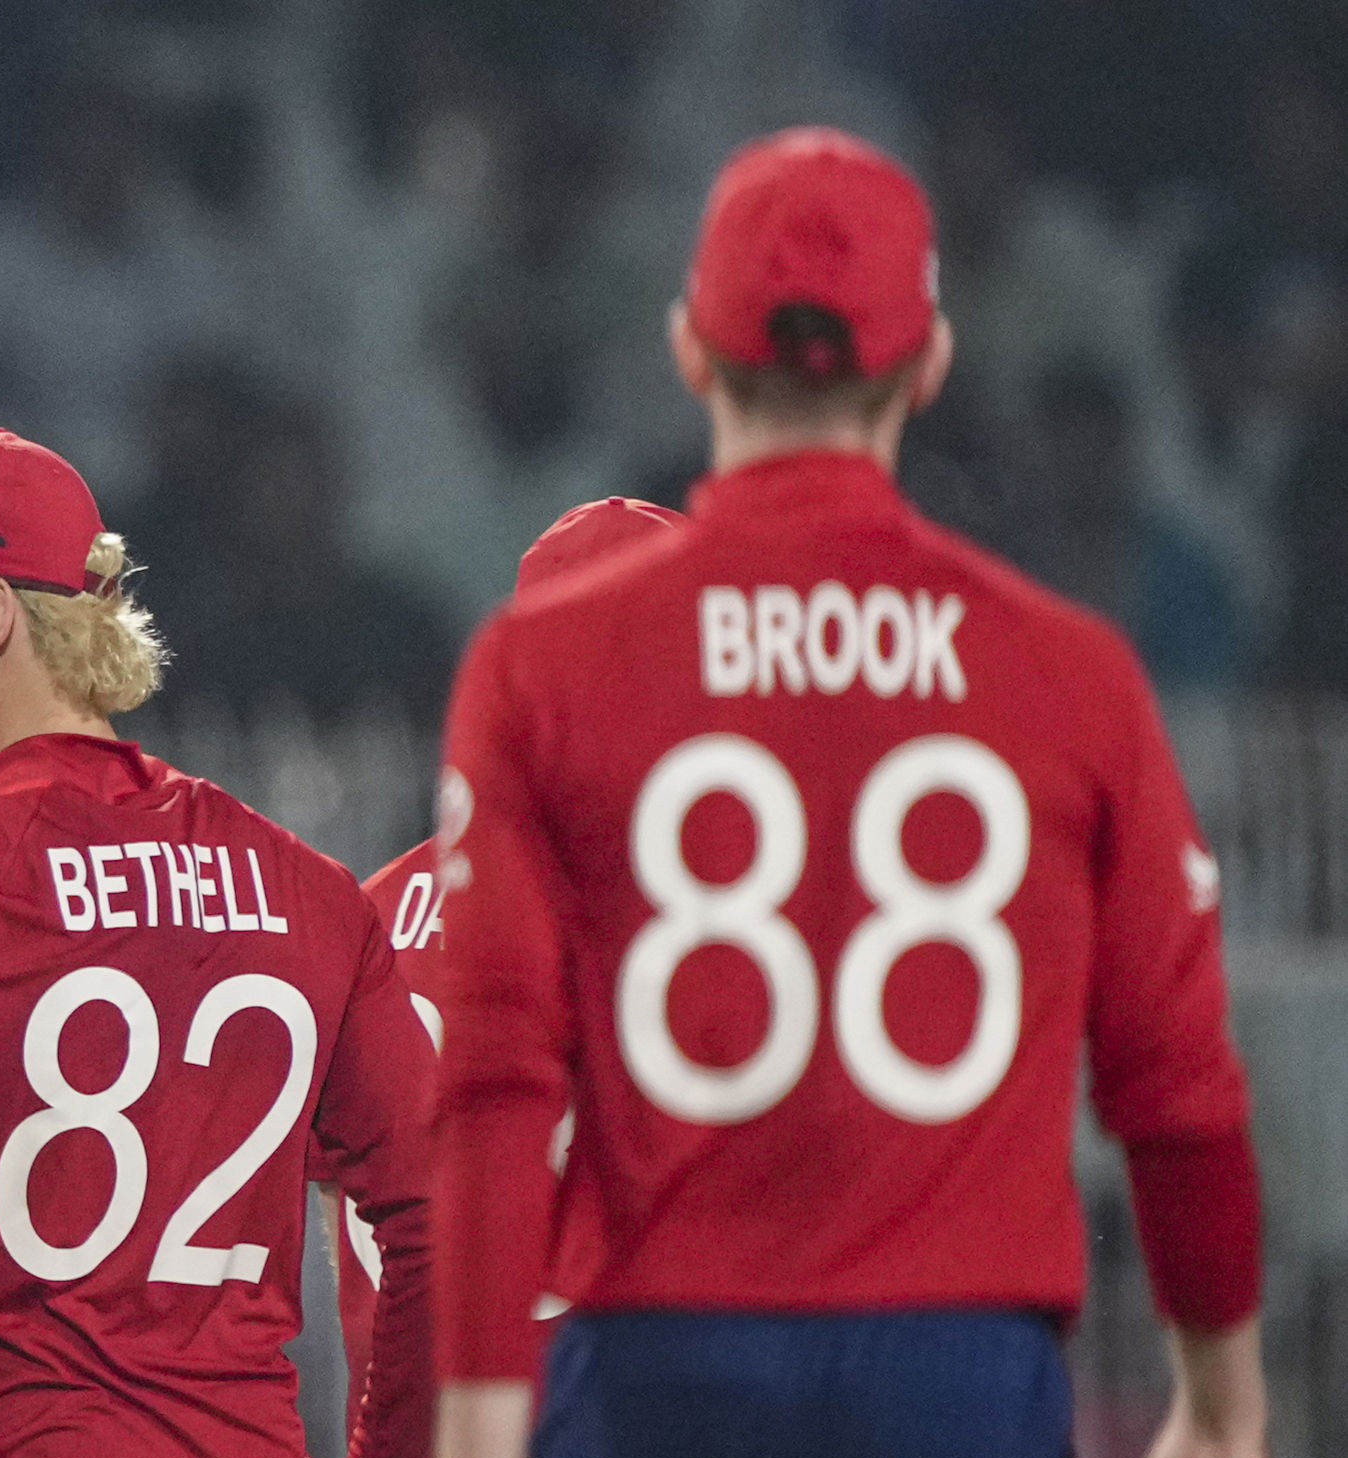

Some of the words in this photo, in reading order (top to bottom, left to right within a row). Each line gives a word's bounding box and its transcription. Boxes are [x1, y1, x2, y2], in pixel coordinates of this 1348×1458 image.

[698, 579, 968, 701] BROOK
[47, 841, 289, 934] BETHELL
[614, 731, 1031, 1127] 88
